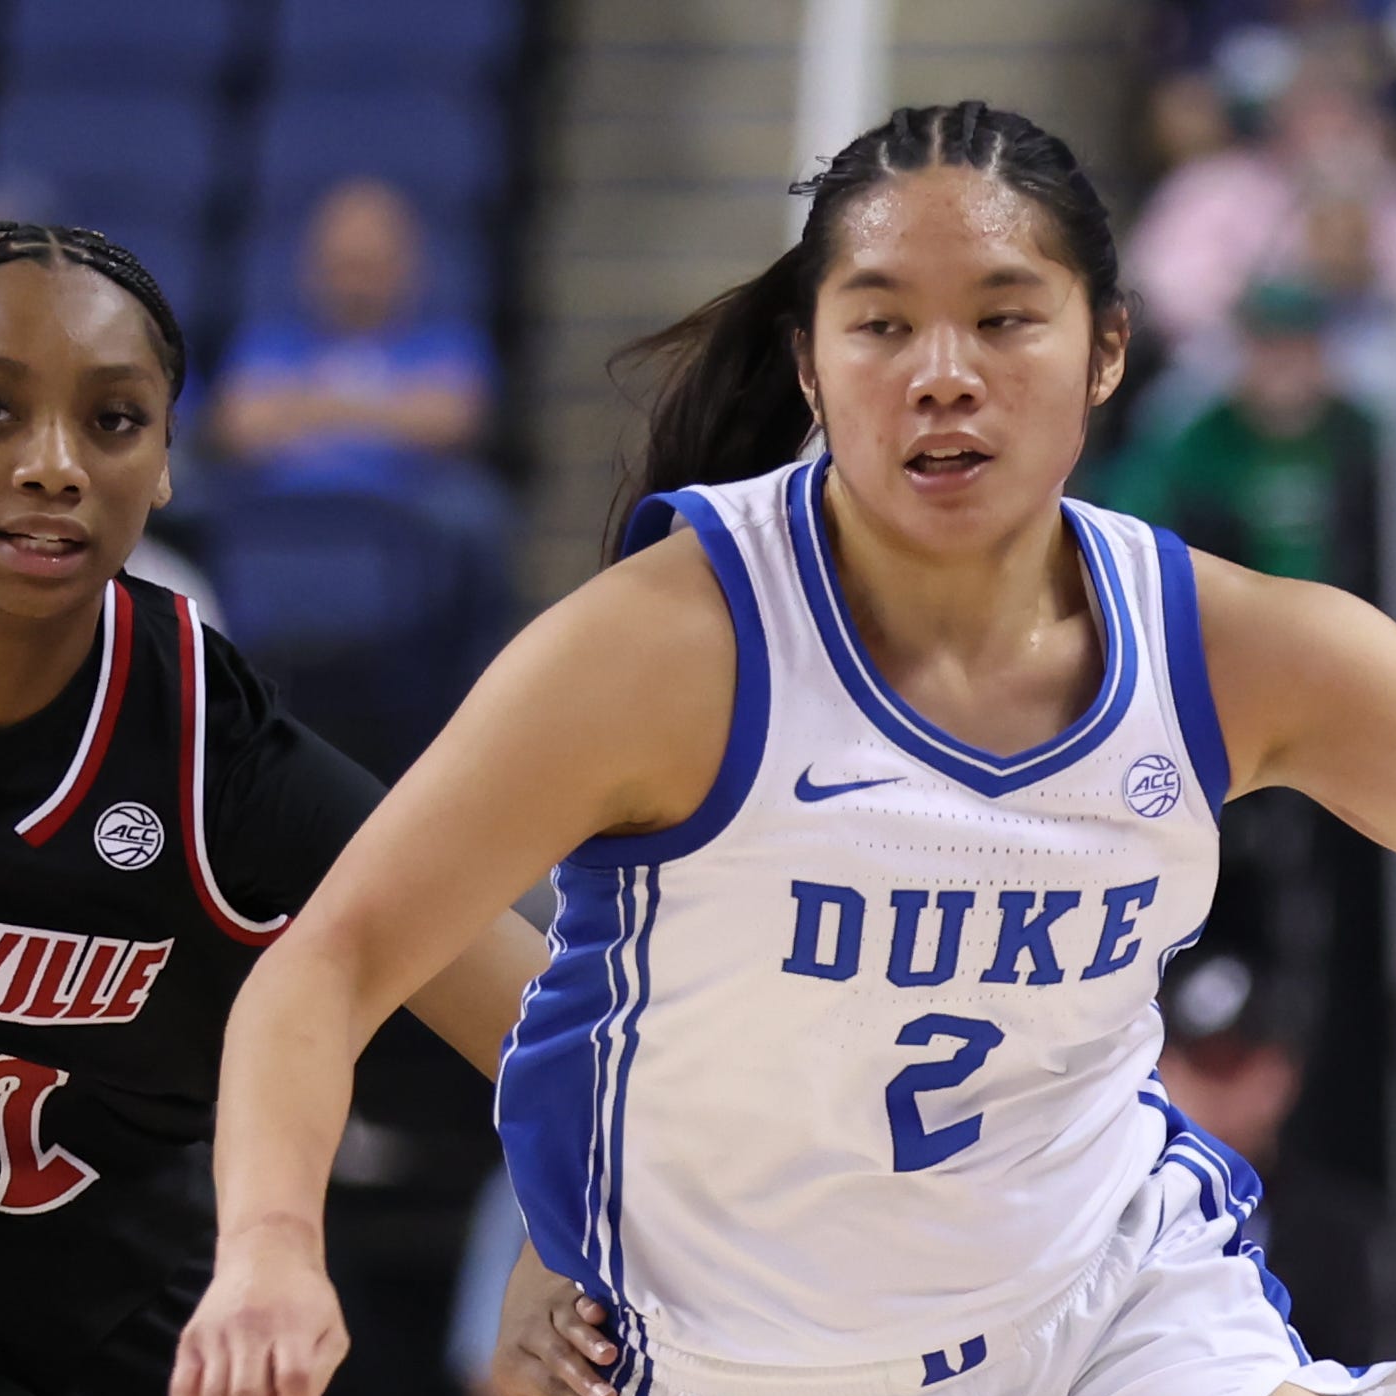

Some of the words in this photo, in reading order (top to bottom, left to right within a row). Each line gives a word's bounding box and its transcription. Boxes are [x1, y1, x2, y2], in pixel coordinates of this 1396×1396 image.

[1132, 771, 1178, 794] ACC
[105, 824, 158, 842] ACC
[781, 876, 1159, 988] DUKE
[885, 1013, 1005, 1172] 2
